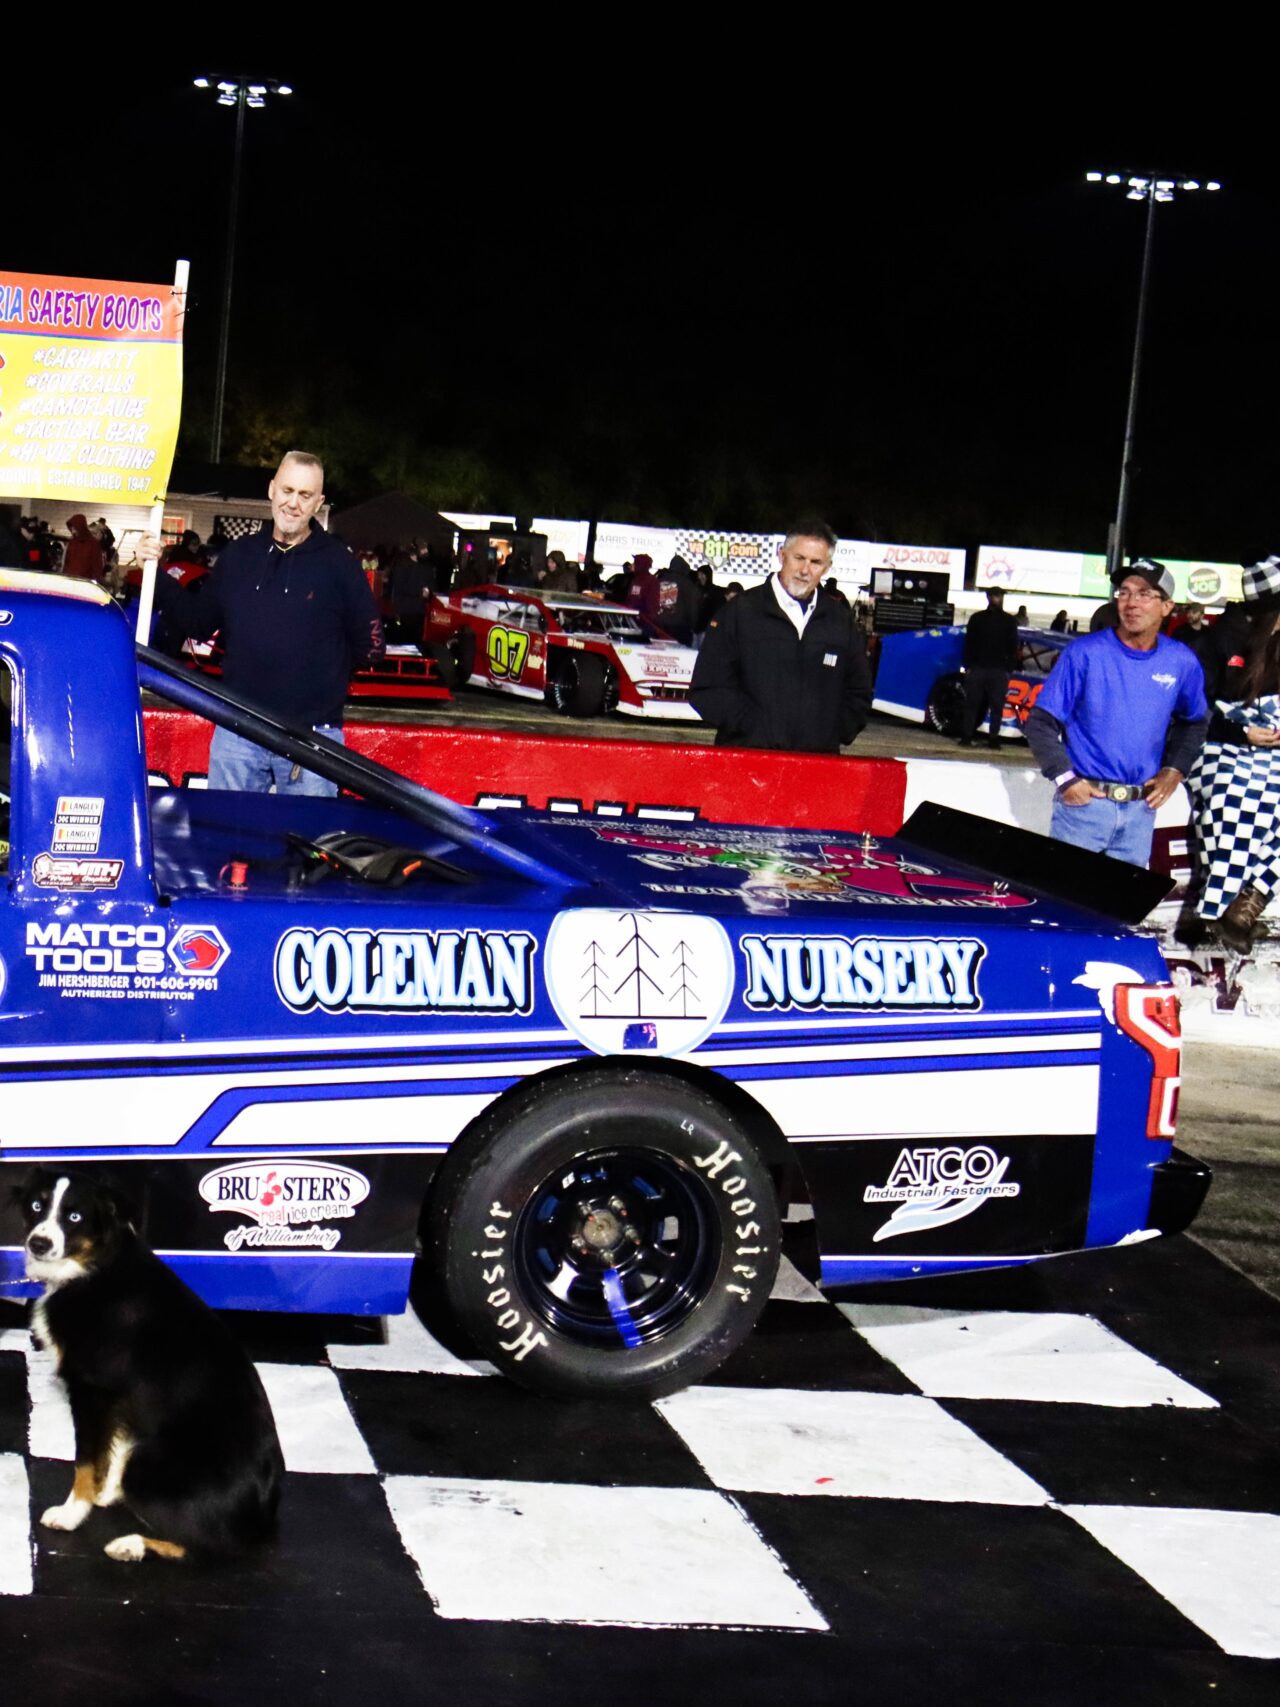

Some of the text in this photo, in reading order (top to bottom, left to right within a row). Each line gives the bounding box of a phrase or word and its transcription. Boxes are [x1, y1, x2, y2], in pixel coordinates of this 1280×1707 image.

[28, 288, 99, 328] SAFETY
[102, 294, 162, 331] BOOTS
[78, 445, 155, 469] CLOTHING
[127, 475, 151, 491] 1947
[599, 535, 663, 549] ARRIS TRUCK
[1192, 580, 1218, 593] JOE
[487, 625, 530, 681] 07
[69, 801, 100, 812] LANGLEY
[69, 815, 99, 825] WINNER
[65, 829, 96, 839] LANGLEY
[66, 842, 97, 852] WINNER
[50, 860, 121, 877] SMITH
[25, 922, 166, 948] MATCO
[25, 948, 166, 974] TOOLS
[276, 929, 986, 1013] COLEMAN NURSERY
[38, 974, 218, 991] JIM HERSHBERGER 901-606-9961
[127, 990, 195, 1001] DISTRIBUTOR
[680, 1118, 694, 1136] LR
[887, 1145, 998, 1185] ATCO
[866, 1184, 1018, 1200] Industrial Fasteners
[261, 1203, 348, 1223] real ice cream
[691, 1140, 769, 1303] Hoosier
[246, 1228, 340, 1249] Williamsburg
[470, 1199, 550, 1362] Hoosier
